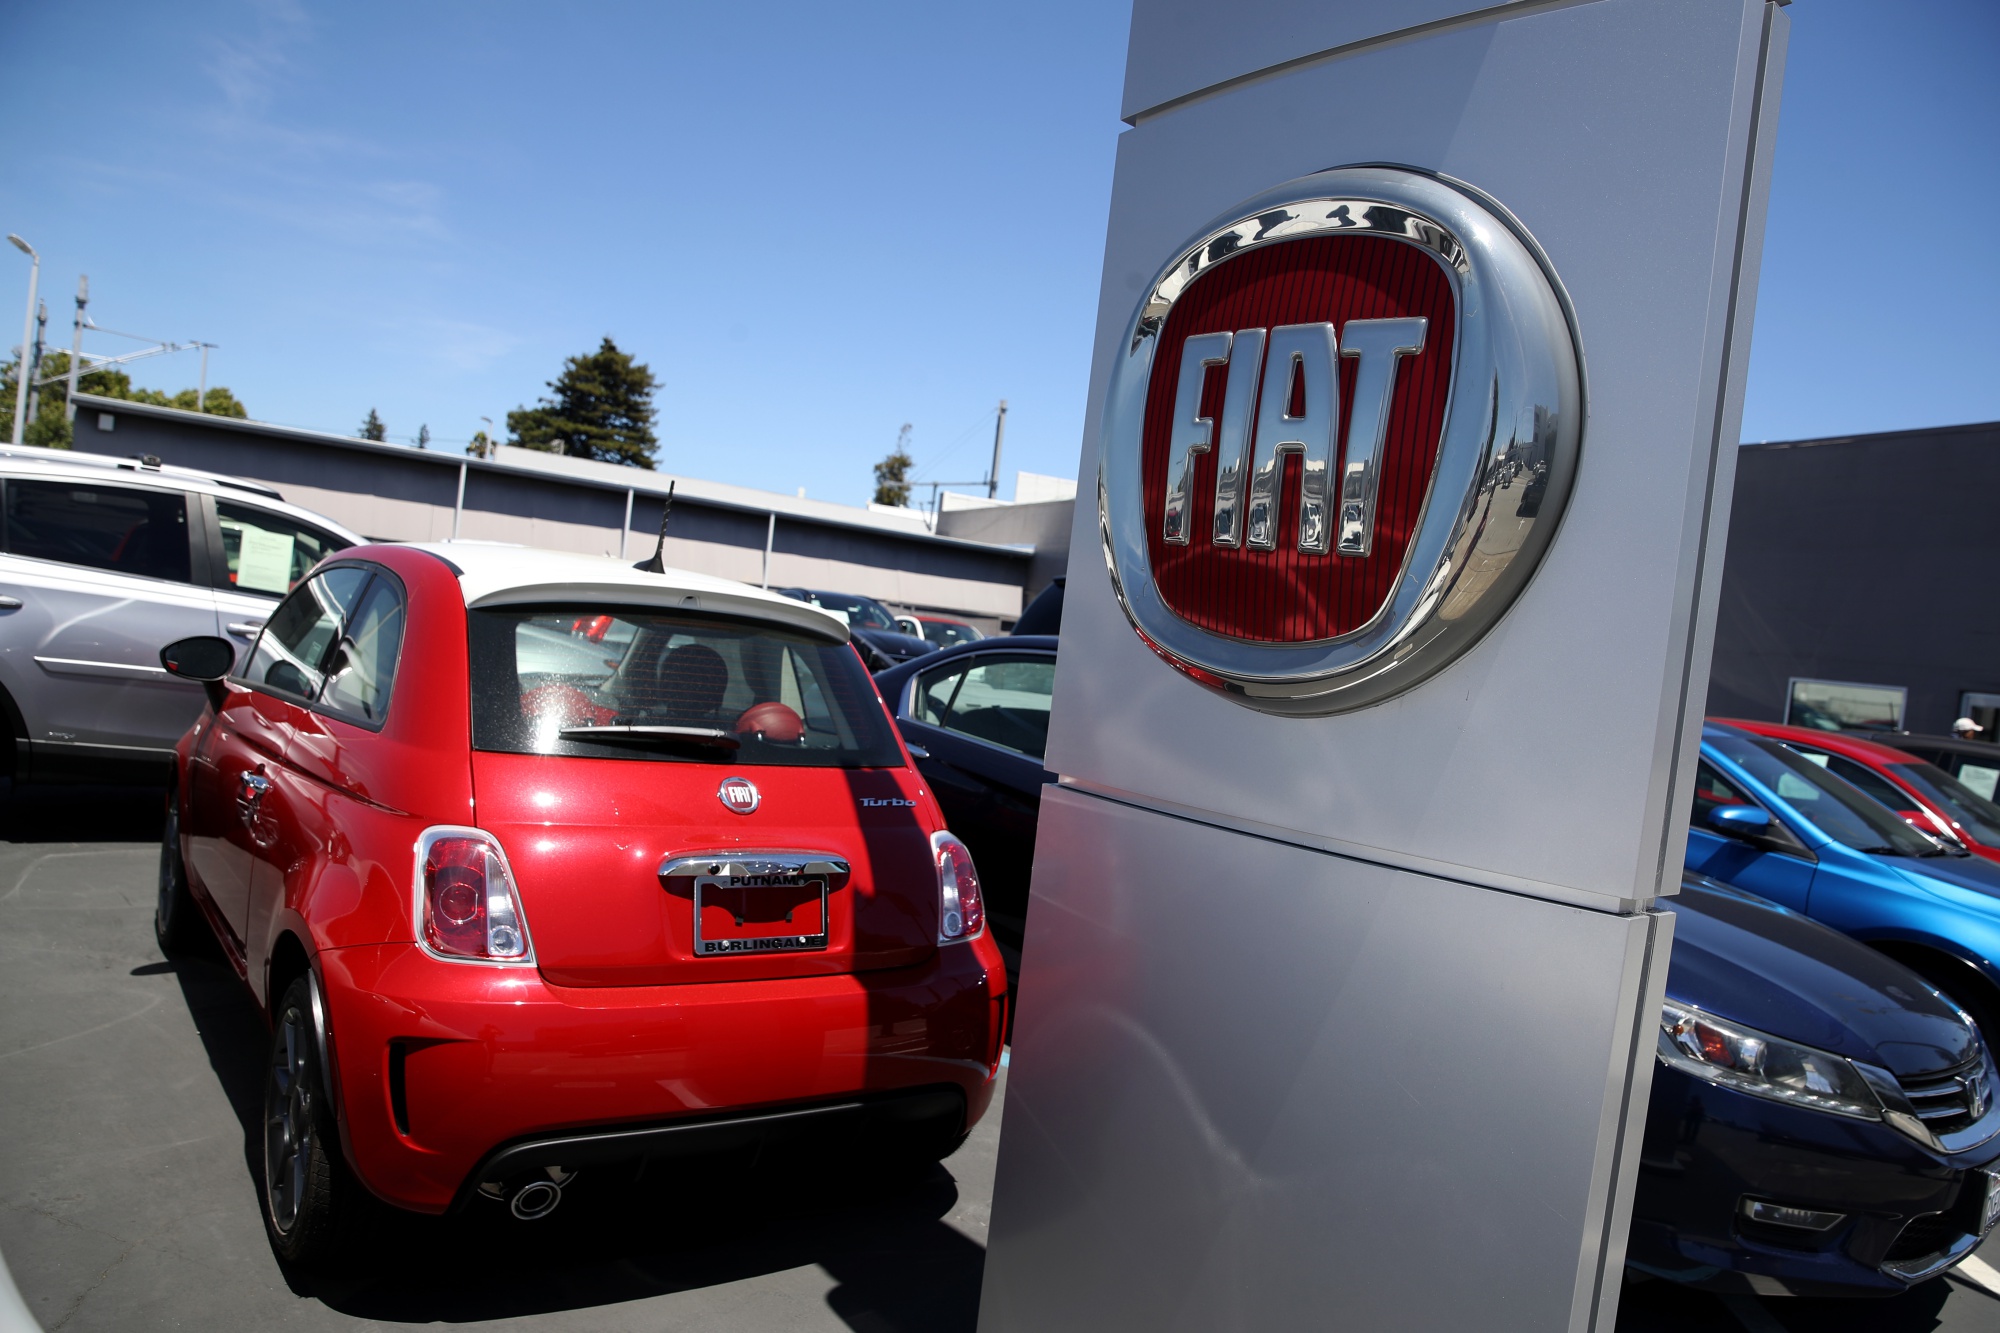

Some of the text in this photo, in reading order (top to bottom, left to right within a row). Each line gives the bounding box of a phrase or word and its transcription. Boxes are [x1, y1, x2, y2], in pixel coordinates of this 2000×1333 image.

[1163, 316, 1428, 558] FIAT
[728, 786, 750, 803] FIAT
[859, 797, 916, 807] Turbo
[730, 876, 799, 887] PUTNAM
